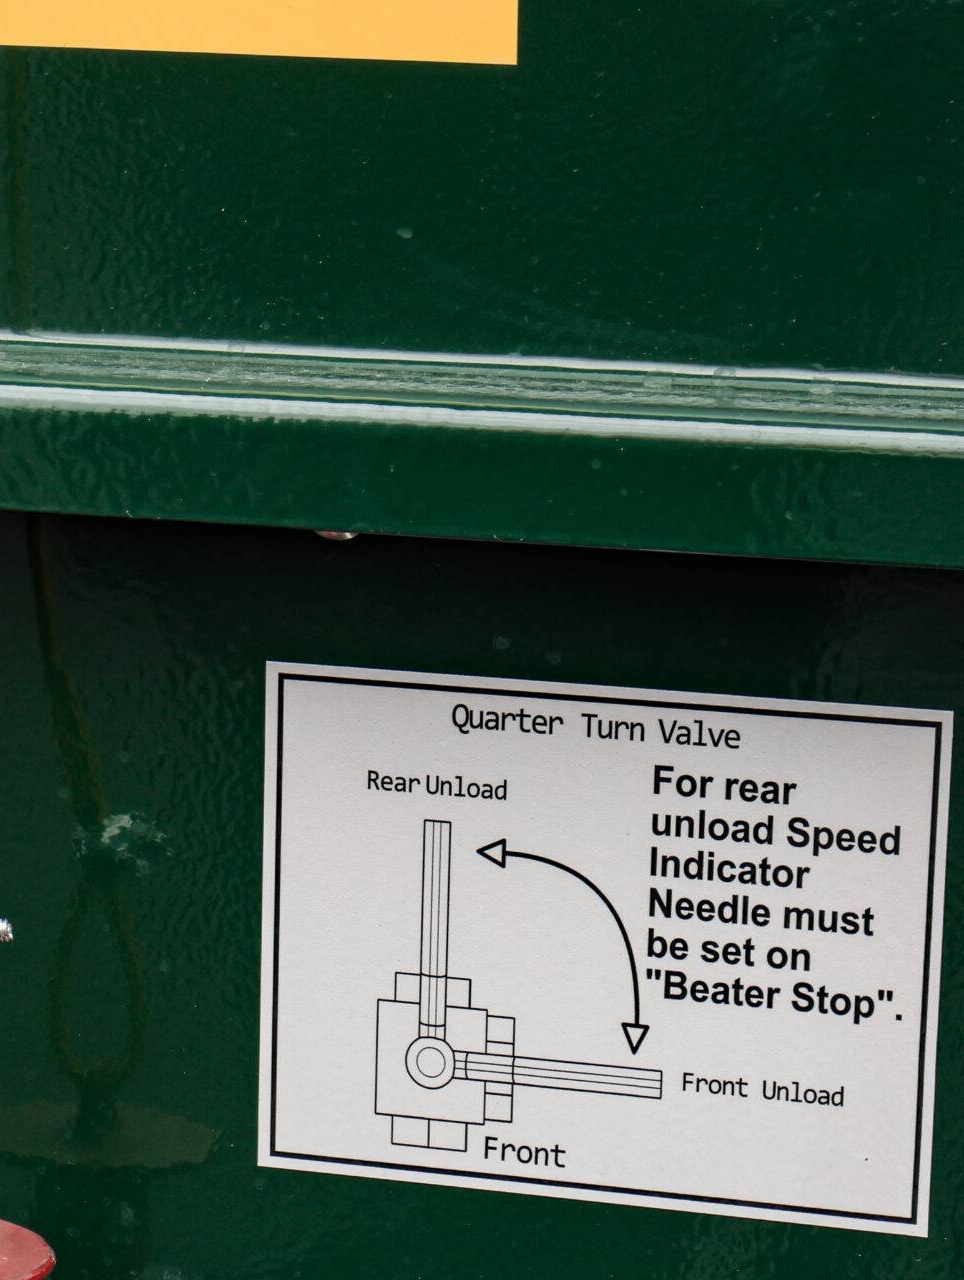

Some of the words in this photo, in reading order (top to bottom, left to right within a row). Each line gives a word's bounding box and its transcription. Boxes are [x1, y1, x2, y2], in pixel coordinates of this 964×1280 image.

[451, 703, 565, 735] Quarter
[581, 712, 646, 742] Turn
[658, 718, 741, 750] Valve
[367, 769, 421, 794] Rear
[425, 774, 508, 801] Unload
[653, 764, 714, 799] For
[724, 778, 798, 806] rear
[651, 809, 774, 846] unload
[786, 816, 901, 856] Speed
[650, 846, 811, 890] Indicator
[648, 887, 771, 927] Needle
[783, 905, 875, 937] must
[647, 927, 689, 961] be
[700, 937, 755, 967] set
[766, 946, 811, 972] on
[646, 968, 782, 1009] "Beater
[791, 981, 903, 1025] Stop".
[682, 1071, 749, 1098] Front
[762, 1079, 845, 1107] Unload
[484, 1135, 567, 1169] Front
